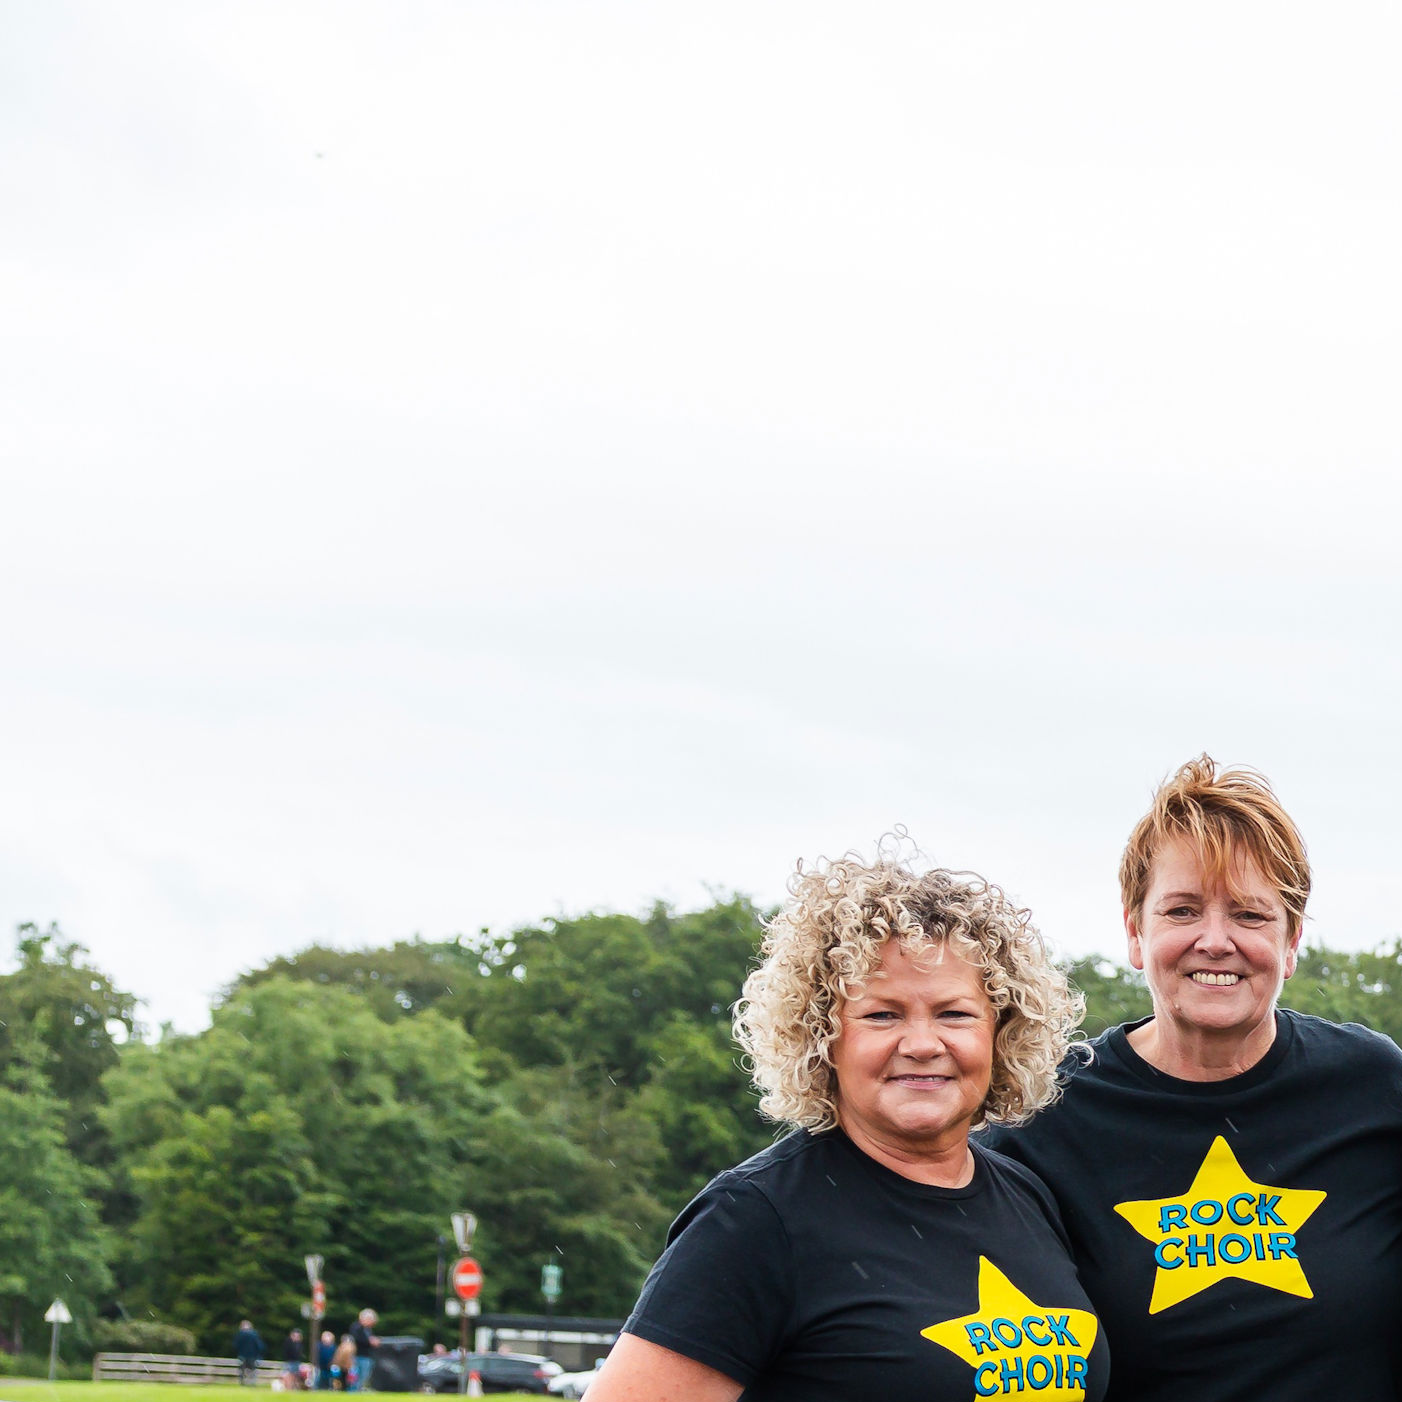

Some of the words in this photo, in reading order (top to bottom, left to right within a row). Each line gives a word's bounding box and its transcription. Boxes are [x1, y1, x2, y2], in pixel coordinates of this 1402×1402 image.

[1158, 1192, 1287, 1233] ROCK
[1154, 1232, 1298, 1270] CHOIR
[965, 1314, 1082, 1354] ROCK
[973, 1354, 1089, 1397] CHOIR
